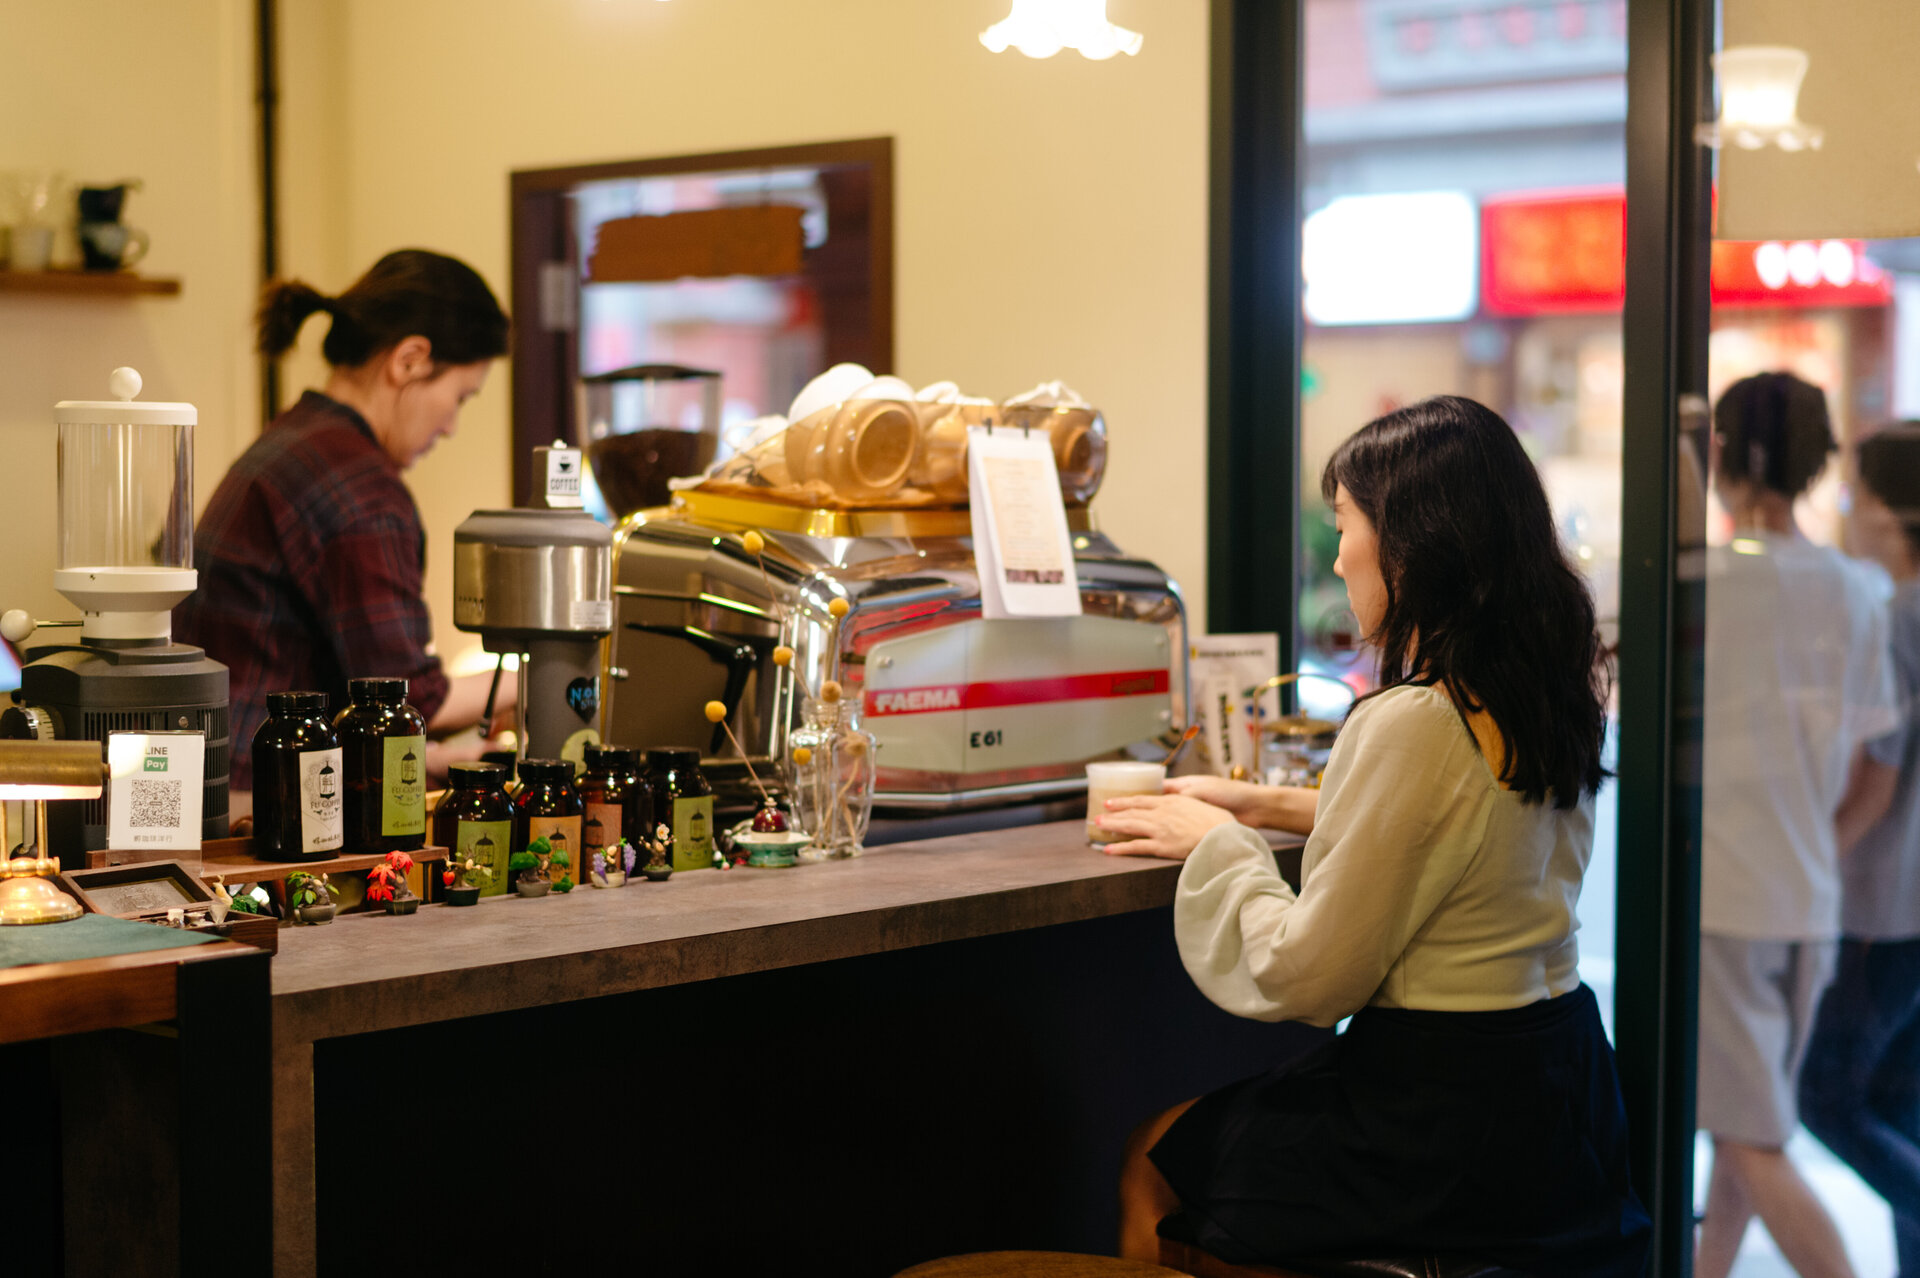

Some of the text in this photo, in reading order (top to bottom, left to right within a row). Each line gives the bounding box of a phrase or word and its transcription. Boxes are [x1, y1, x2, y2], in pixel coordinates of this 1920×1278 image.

[551, 478, 578, 491] COFFEE
[875, 688, 960, 713] FAEMA
[145, 747, 168, 755] LINE
[146, 759, 166, 770] Pay
